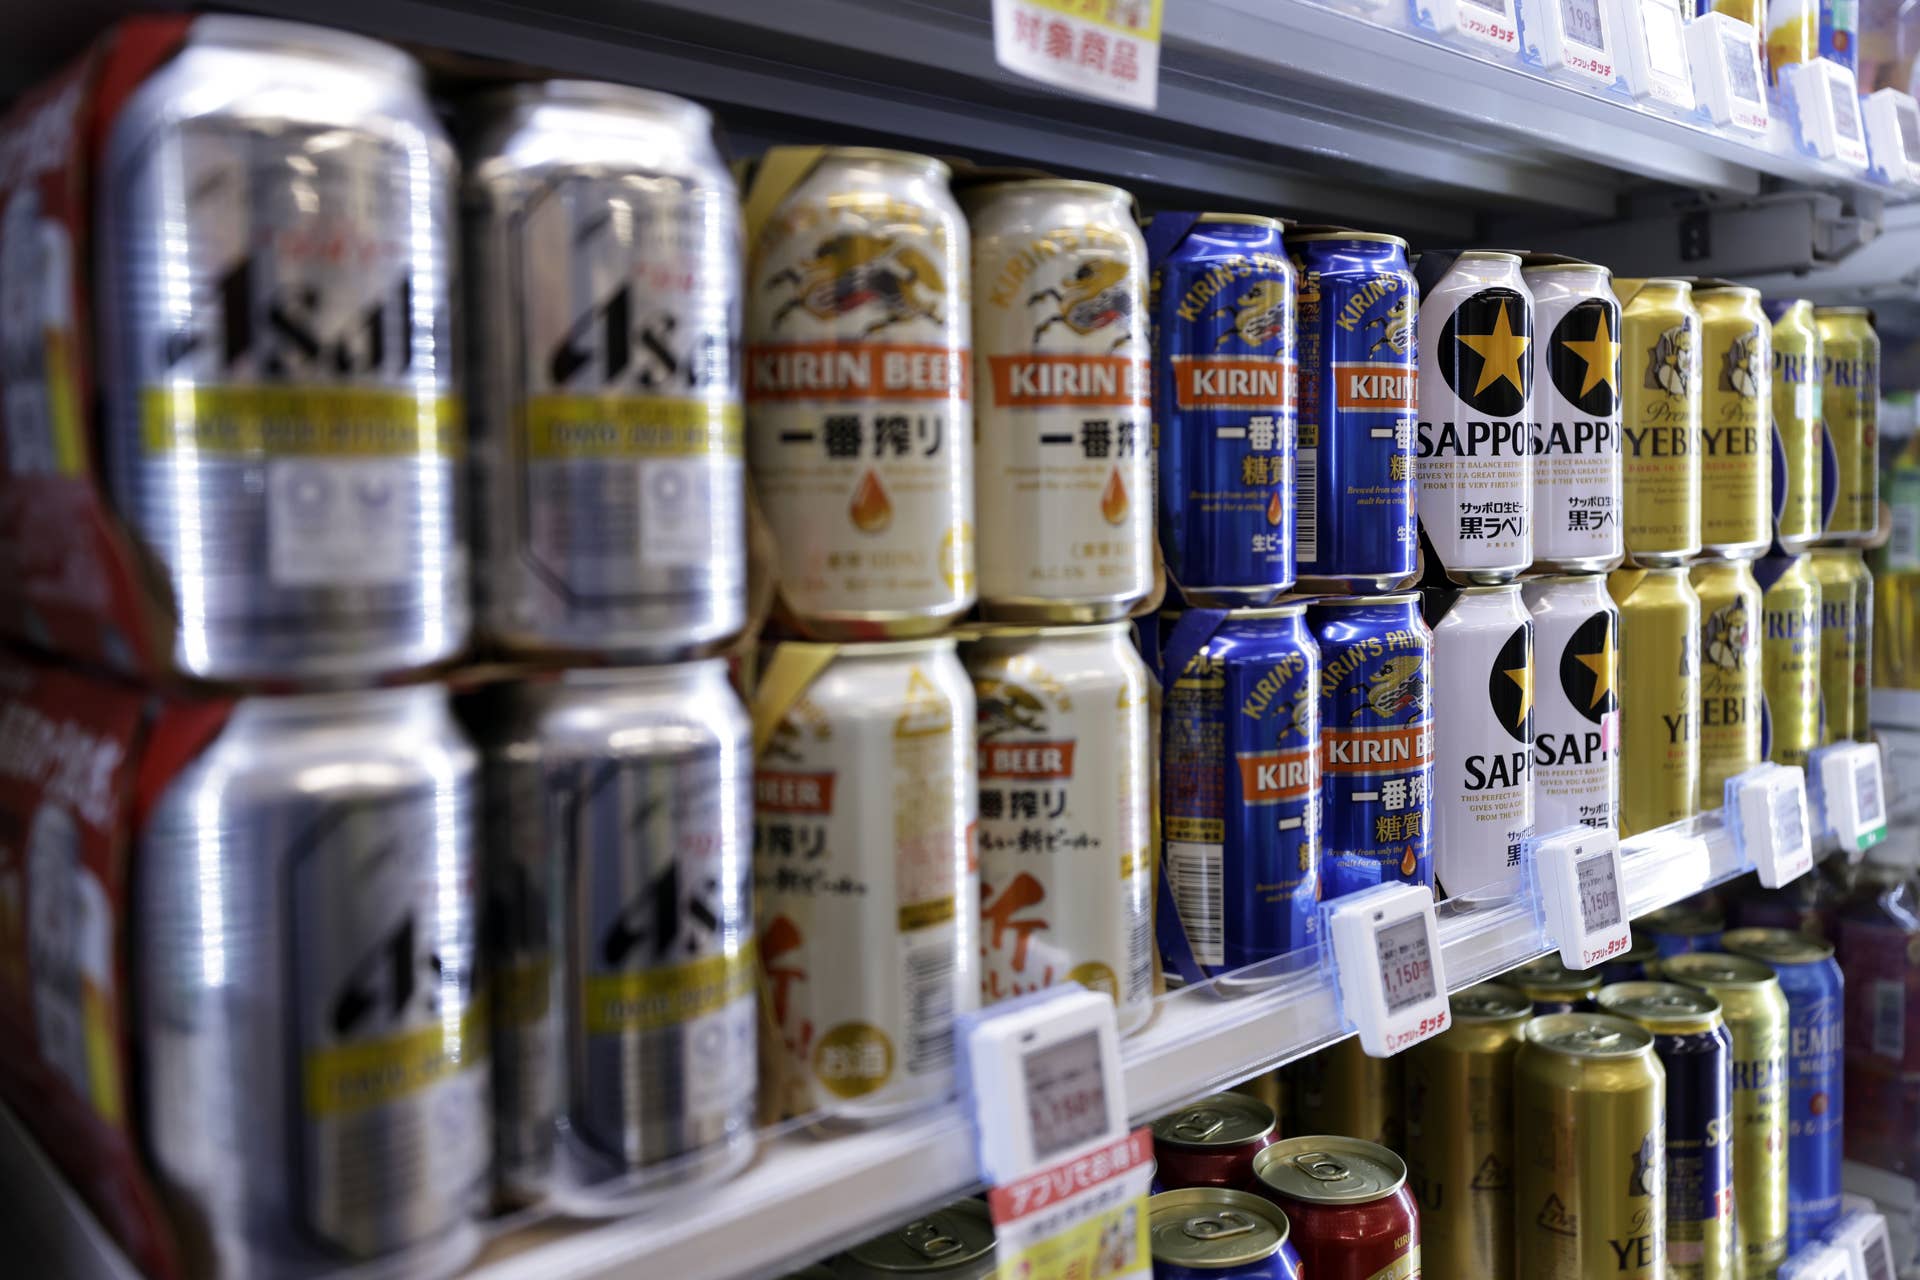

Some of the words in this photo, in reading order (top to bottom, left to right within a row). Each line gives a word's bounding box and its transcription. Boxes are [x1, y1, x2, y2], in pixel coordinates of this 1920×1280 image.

[1336, 273, 1398, 332] KIRIN'S
[752, 350, 871, 391] KIRIN
[1008, 361, 1117, 397] KIRIN
[1192, 368, 1278, 397] KIRIN
[779, 414, 944, 460] 一番搾り
[1701, 426, 1759, 457] YEB
[1417, 472, 1442, 480] GIVES
[1470, 471, 1496, 479] GREAT
[1429, 462, 1466, 470] PERFET
[1423, 482, 1448, 490] FROM
[1468, 480, 1489, 489] VERY
[1459, 501, 1527, 514] サッポロ生ビー
[1242, 654, 1305, 721] KIRIN'S
[993, 748, 1064, 773] BEER
[1329, 736, 1409, 764] KIRIN
[1535, 732, 1608, 767] SAP
[1461, 794, 1480, 802] THIS
[1481, 792, 1511, 801] PERFECT
[1469, 803, 1493, 812] GIVES
[1494, 802, 1509, 811] YOU
[1476, 813, 1497, 822] FROM
[1500, 812, 1512, 820] THE
[1581, 890, 1609, 917] 1,150
[1384, 960, 1420, 994] 1,150
[1393, 1232, 1412, 1250] KIRI
[1607, 1233, 1656, 1272] YE
